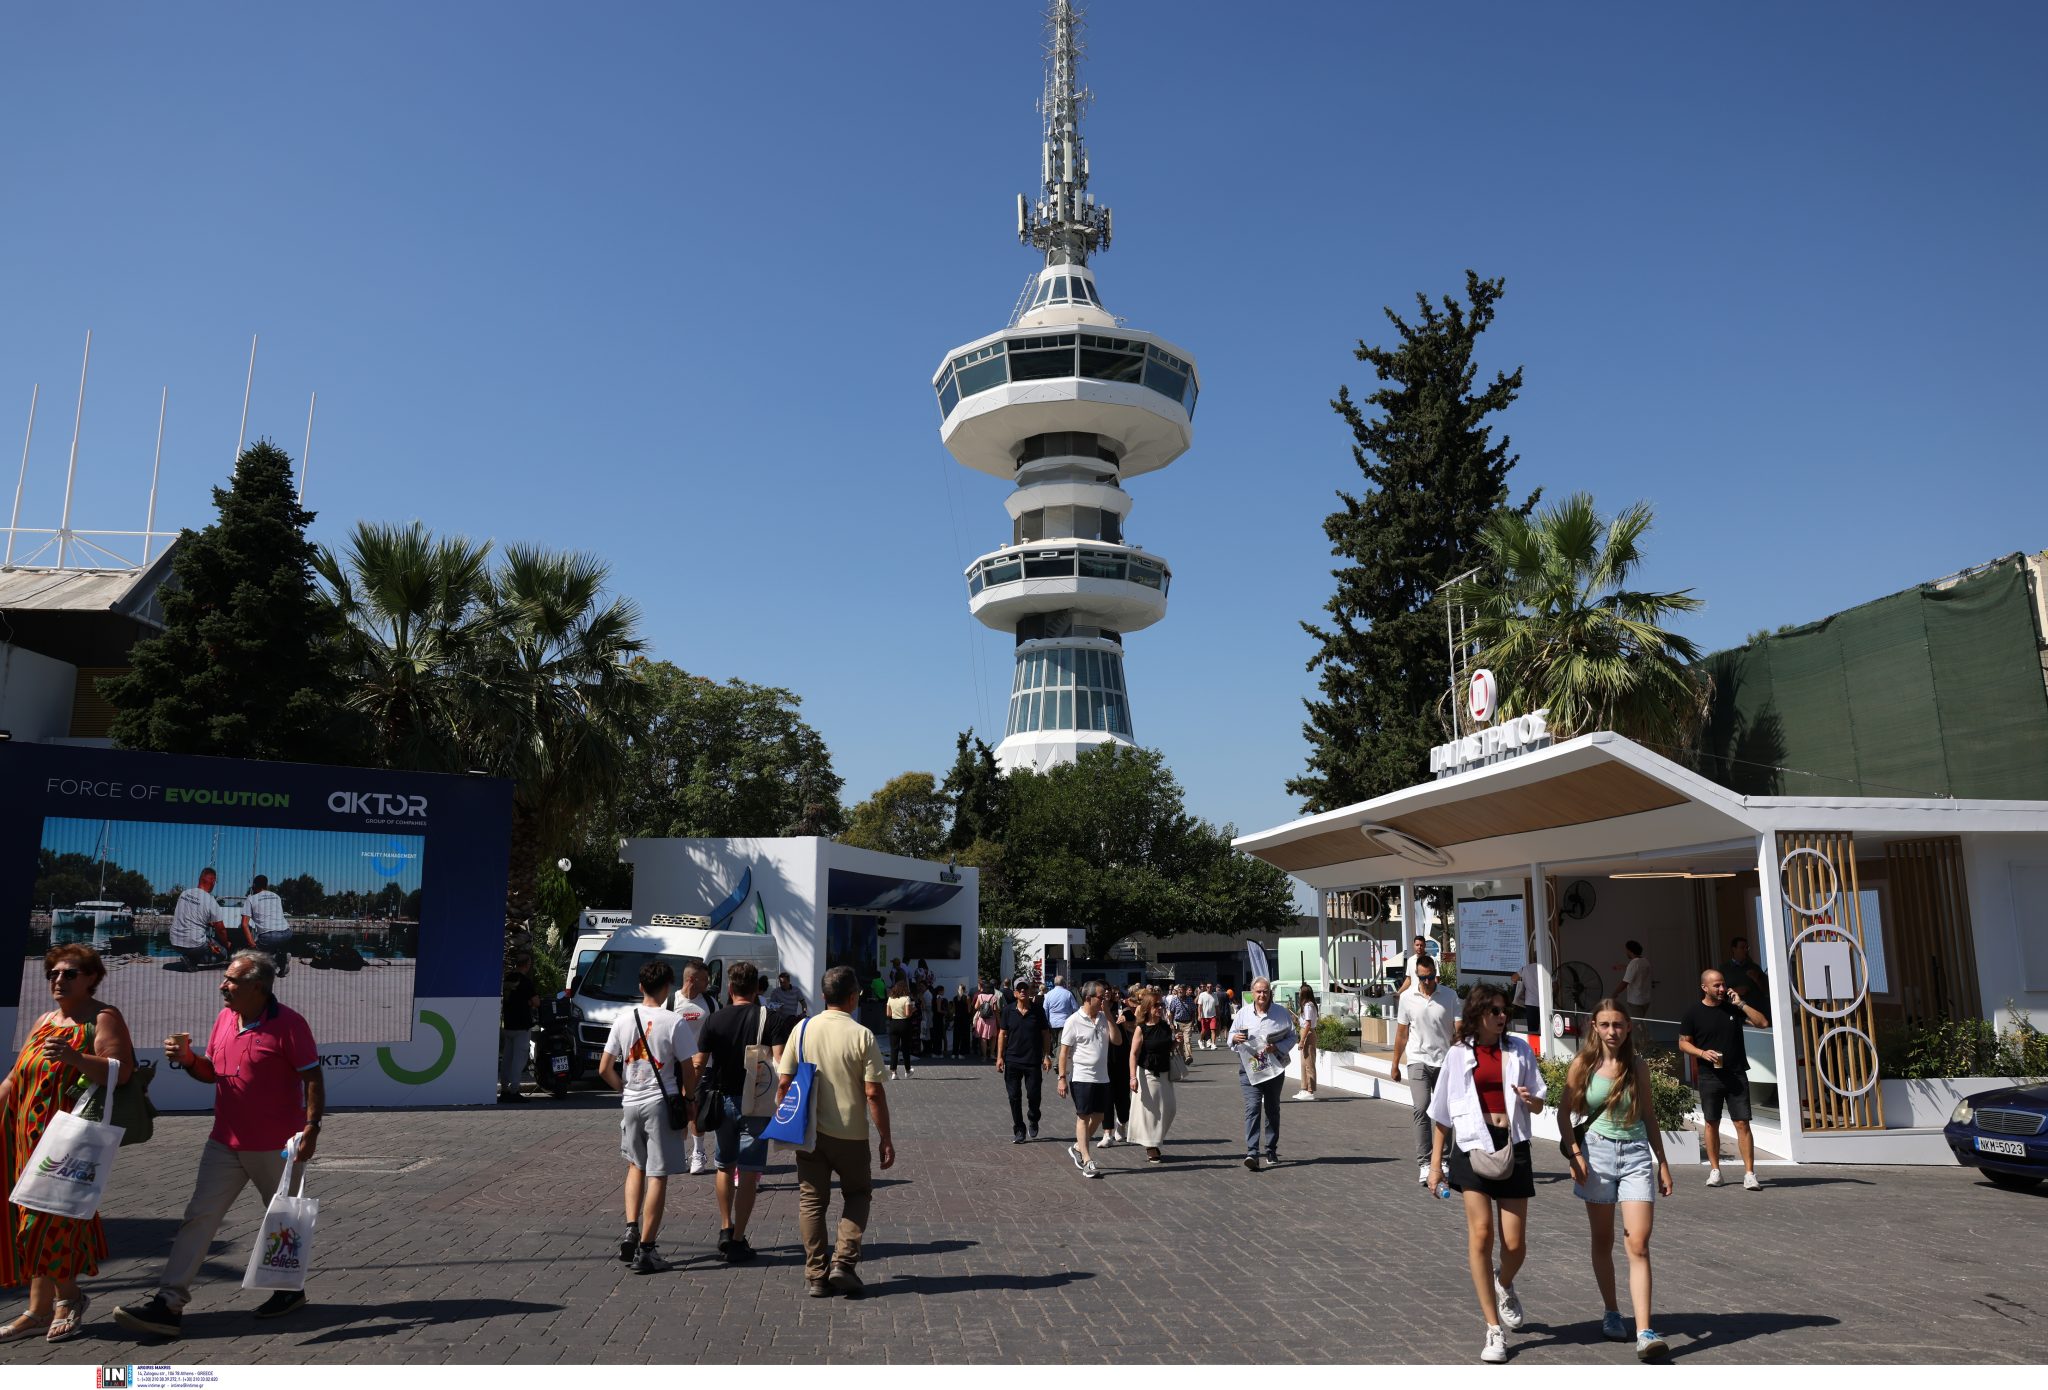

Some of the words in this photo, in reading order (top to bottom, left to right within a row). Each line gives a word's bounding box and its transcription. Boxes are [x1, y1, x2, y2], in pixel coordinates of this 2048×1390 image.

[46, 778, 122, 798] FORCE
[130, 784, 161, 800] OF
[165, 787, 290, 808] EVOLUTION
[383, 851, 417, 859] MANAGEMENT
